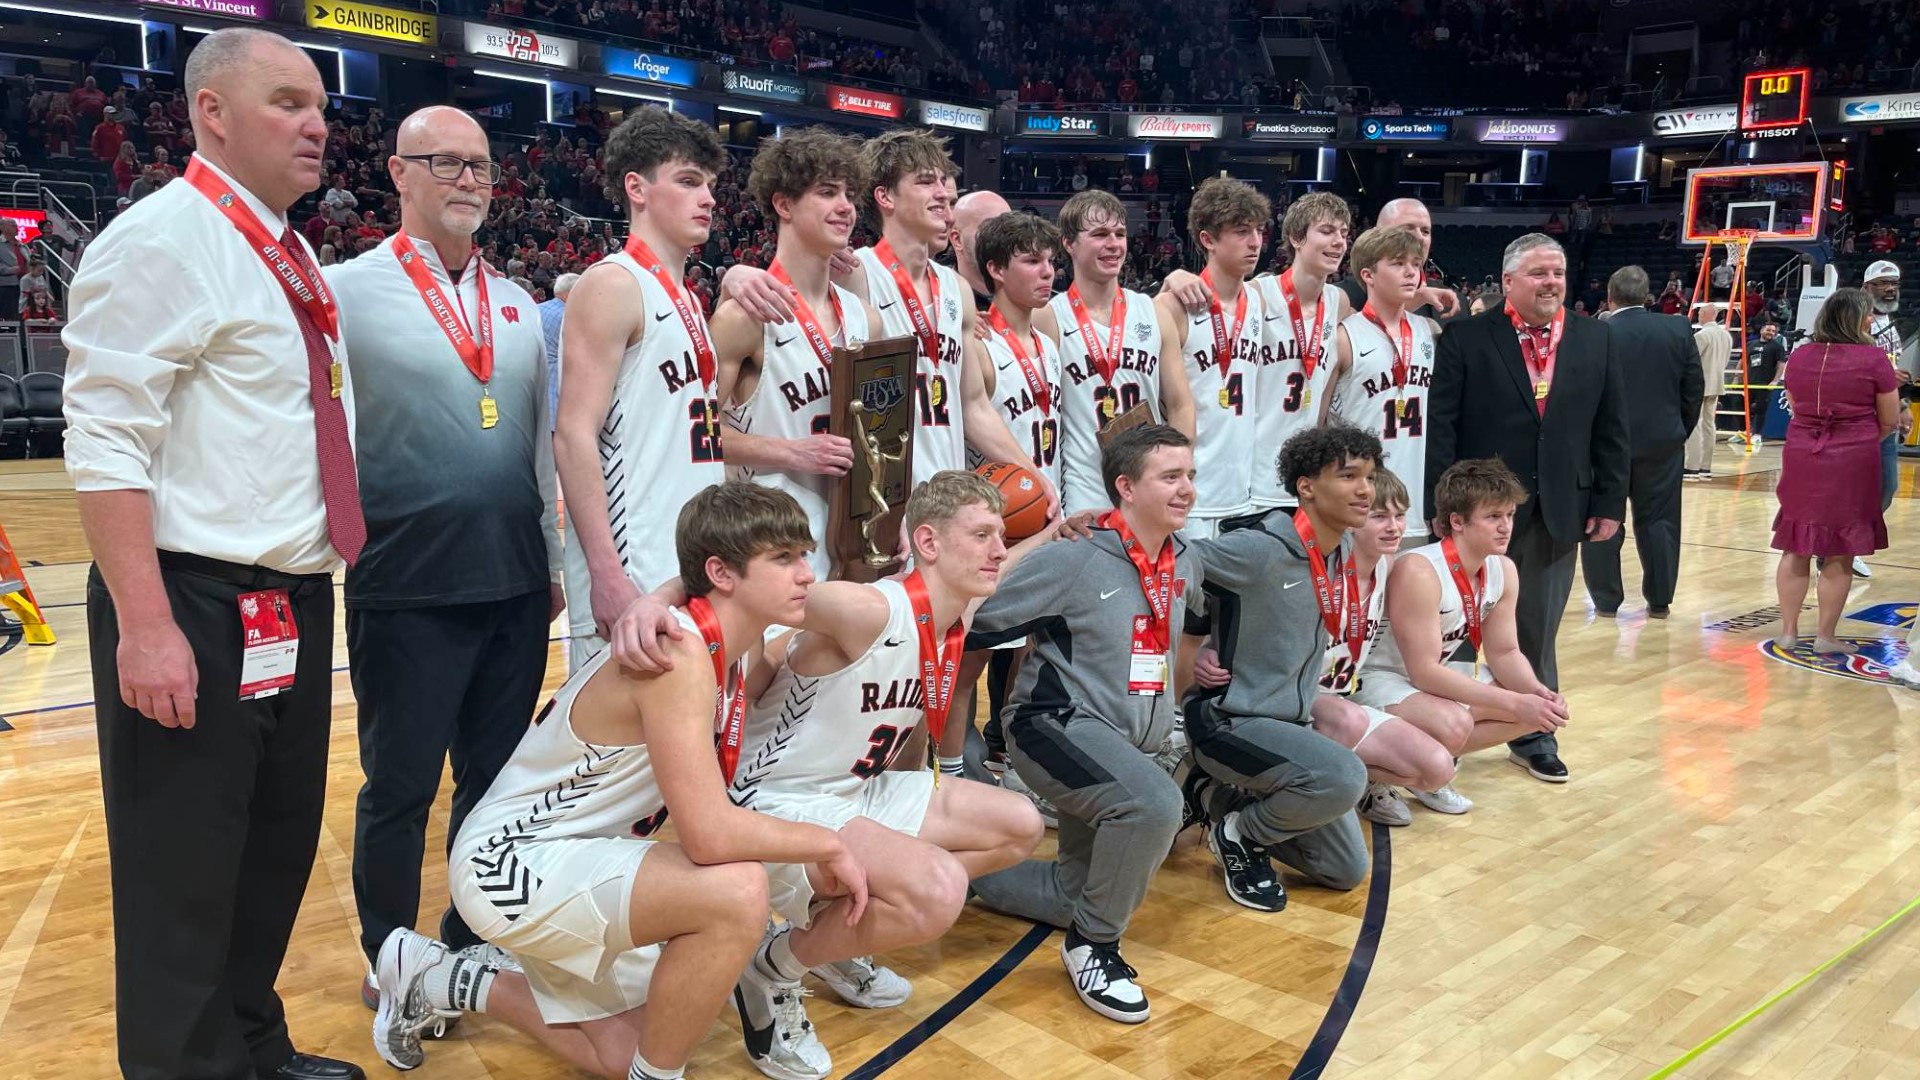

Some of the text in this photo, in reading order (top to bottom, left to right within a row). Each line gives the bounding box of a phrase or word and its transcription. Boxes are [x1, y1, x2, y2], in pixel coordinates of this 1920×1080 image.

[203, 0, 257, 15] Vincent
[333, 7, 431, 39] GAINBRIDGE
[486, 34, 504, 48] 93.5
[505, 30, 532, 47] the
[512, 45, 539, 62] fan
[541, 43, 560, 57] 107.5
[633, 54, 670, 80] Kroger
[739, 74, 806, 96] Ruoff MORTGAGE
[1761, 76, 1790, 95] 0.0
[848, 96, 892, 111] BELLE TIRE
[926, 105, 982, 127] salesforce
[1140, 116, 1211, 135] Bally SPORTS
[1695, 113, 1722, 121] CITY
[1256, 123, 1336, 134] Fanatics Sportsbook
[1384, 124, 1412, 133] Sports
[1413, 124, 1432, 133] Tech
[1511, 124, 1556, 134] DONUTS
[1757, 128, 1798, 138] TISSOT
[263, 245, 314, 303] RUNNER-UP
[425, 288, 466, 346] BASKETBALL
[675, 298, 708, 355] BASKETBALL
[805, 321, 832, 365] RUNNER-UP
[860, 375, 904, 410] IHSAA
[1225, 372, 1244, 416] 4
[1283, 371, 1305, 413] 3
[1383, 396, 1423, 439] 14
[1144, 575, 1166, 620] RUNNER-UP
[1316, 576, 1332, 614] RUNNER-UP
[248, 629, 261, 640] FA
[925, 660, 937, 709] RUNNER-UP
[727, 689, 744, 748] RUNNER-UP
